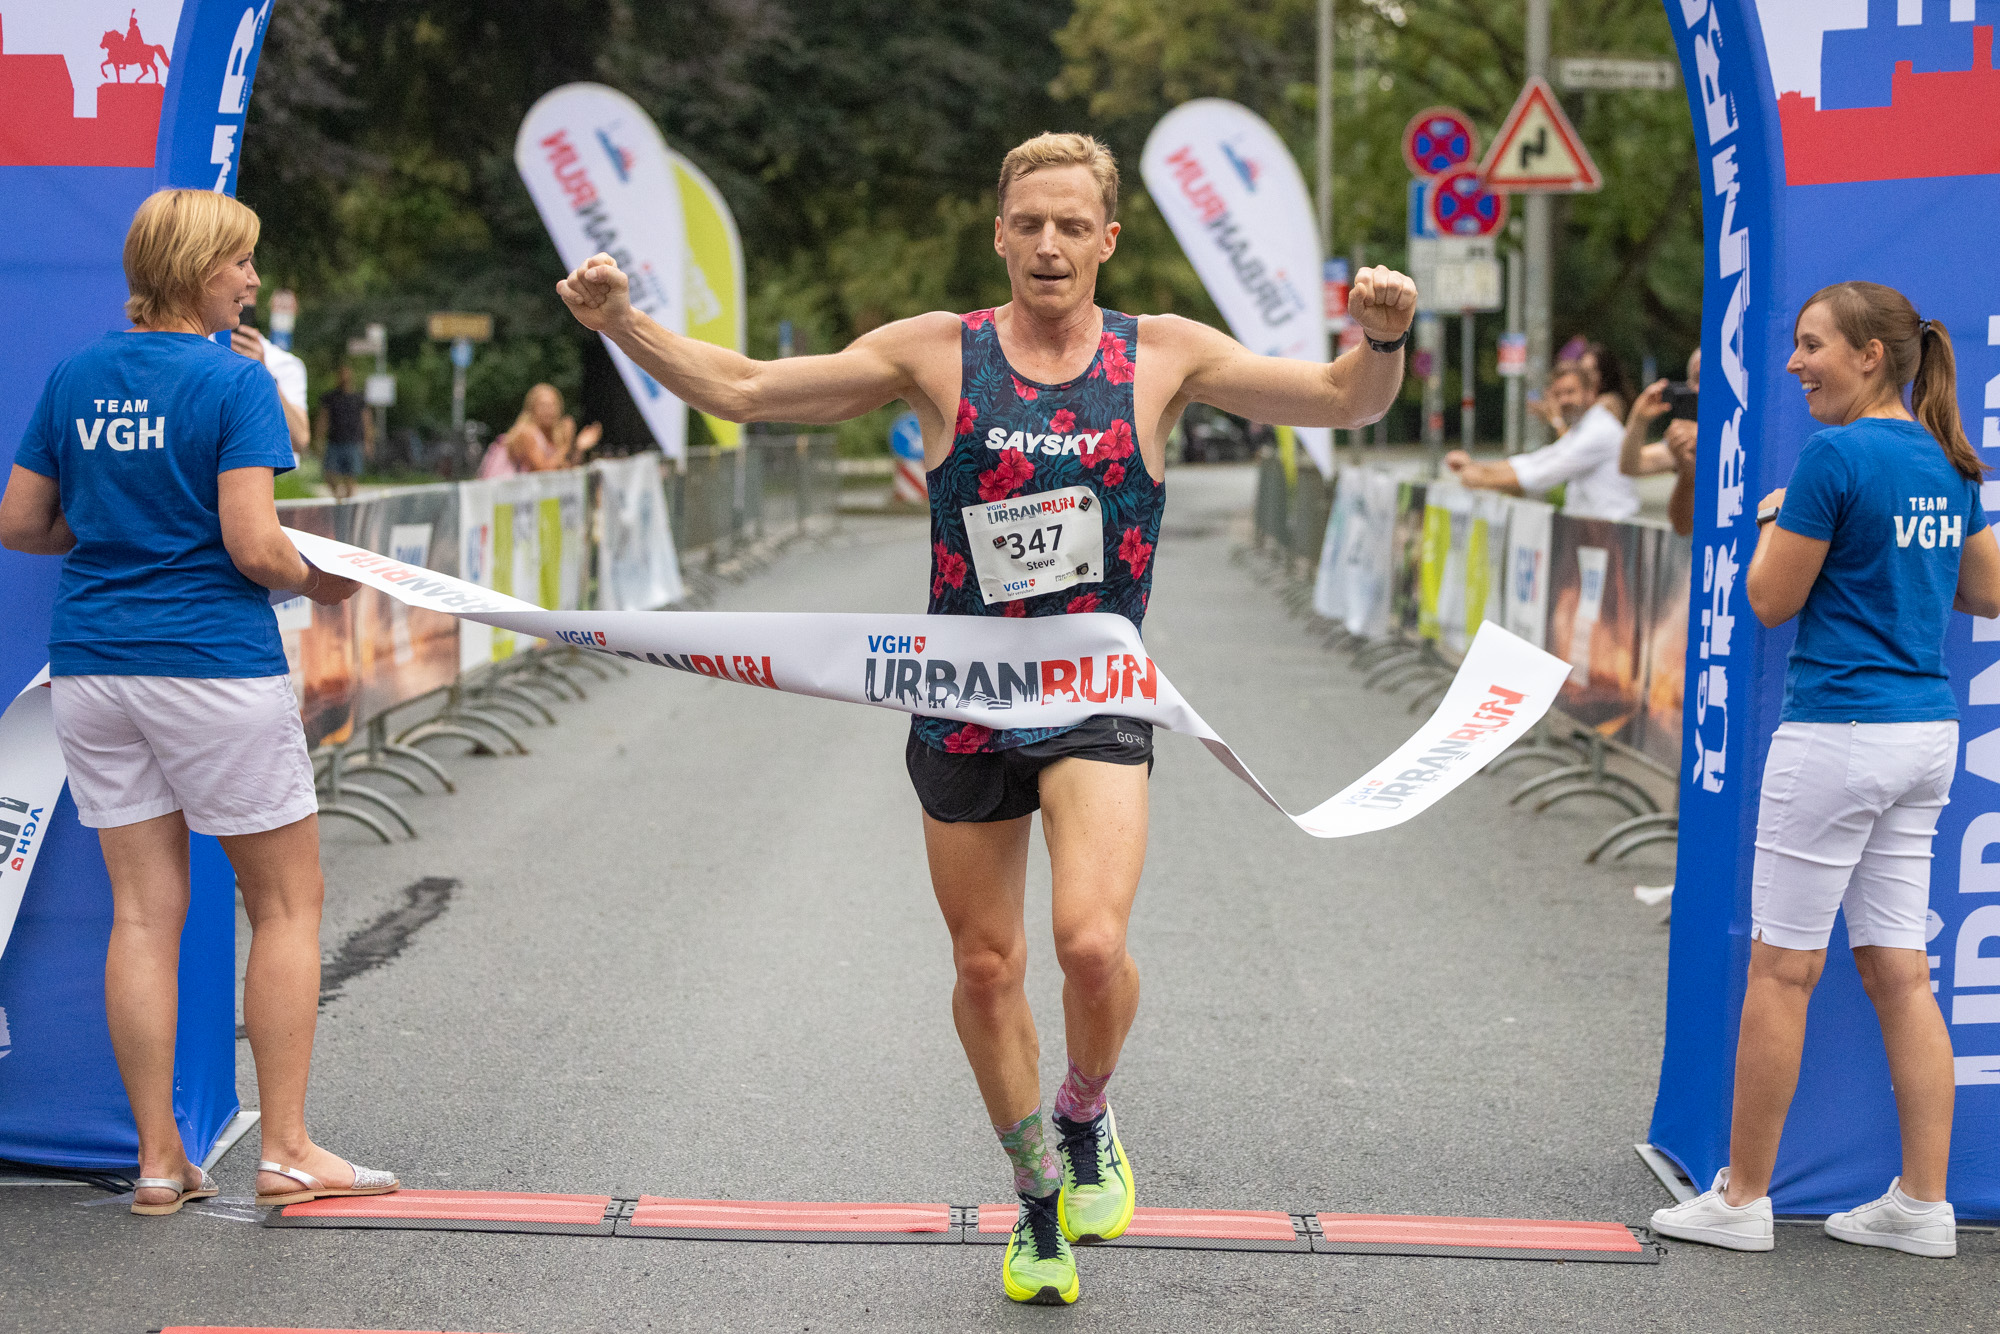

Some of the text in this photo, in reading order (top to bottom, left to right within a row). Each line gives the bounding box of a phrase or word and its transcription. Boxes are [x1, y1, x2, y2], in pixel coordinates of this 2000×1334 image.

[94, 399, 149, 413] TEAM
[75, 416, 165, 452] VGH
[985, 427, 1103, 456] SAYSKY
[986, 504, 1002, 512] VGH
[987, 496, 1075, 524] URBANRUN
[1908, 496, 1948, 511] TEAM
[1006, 524, 1063, 559] 347
[1893, 515, 1962, 550] VGH
[1026, 558, 1056, 571] Steve
[1003, 580, 1028, 592] VGH
[555, 630, 596, 645] VGH
[868, 635, 911, 654] VGH
[864, 653, 1158, 710] URBANRUN
[1360, 684, 1531, 810] URBANRUN
[16, 807, 44, 854] VGH
